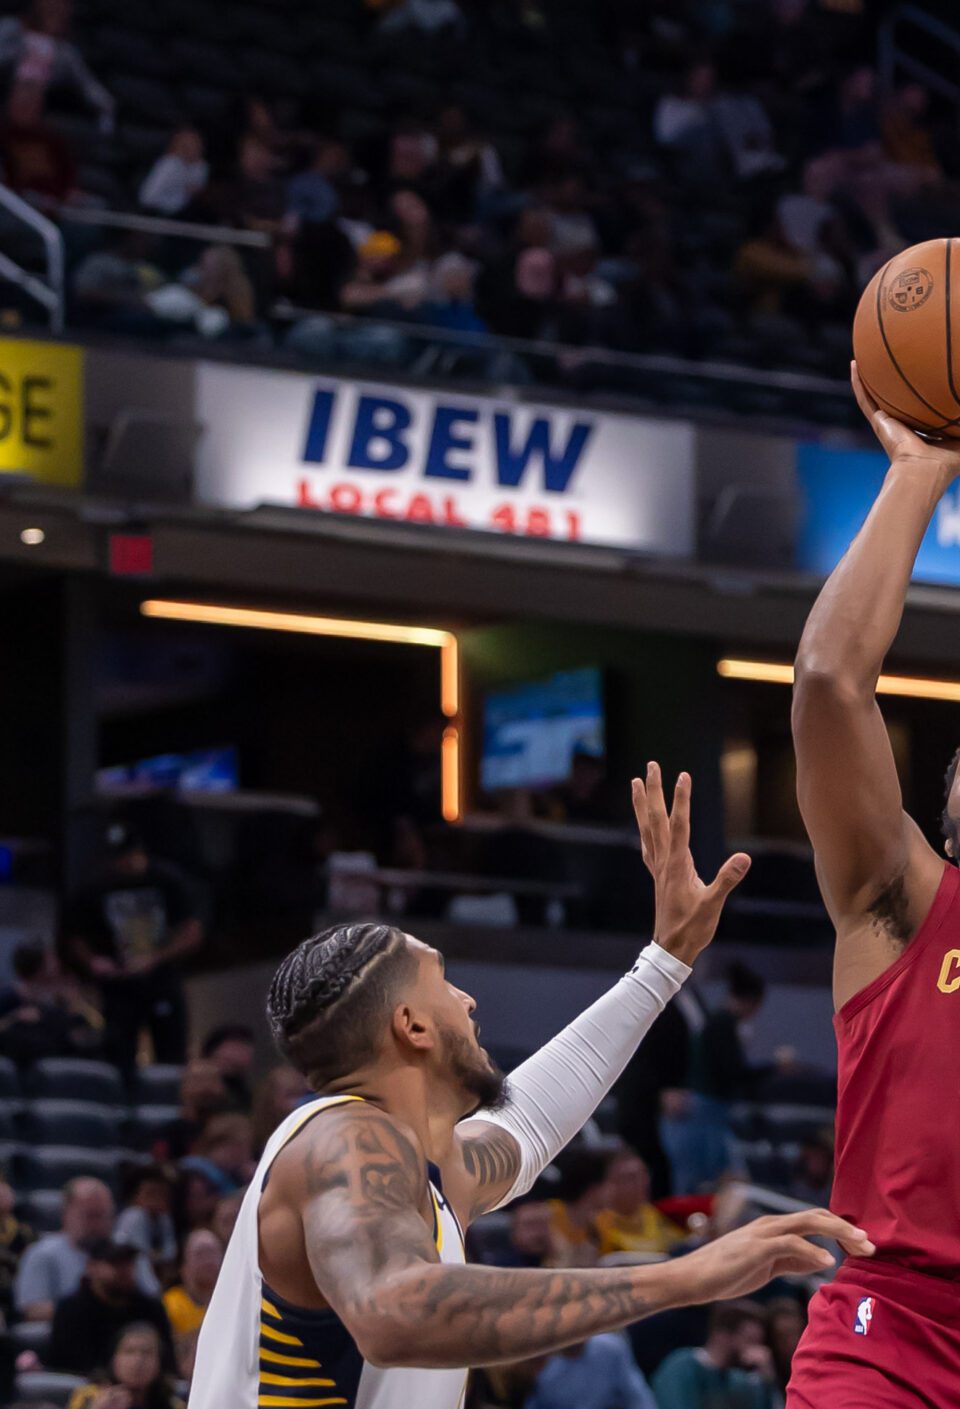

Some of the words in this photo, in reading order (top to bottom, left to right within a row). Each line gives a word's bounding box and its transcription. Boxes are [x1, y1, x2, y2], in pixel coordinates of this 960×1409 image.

[301, 387, 594, 493] IBEW
[296, 480, 468, 528] LOCAL
[490, 501, 582, 542] 481
